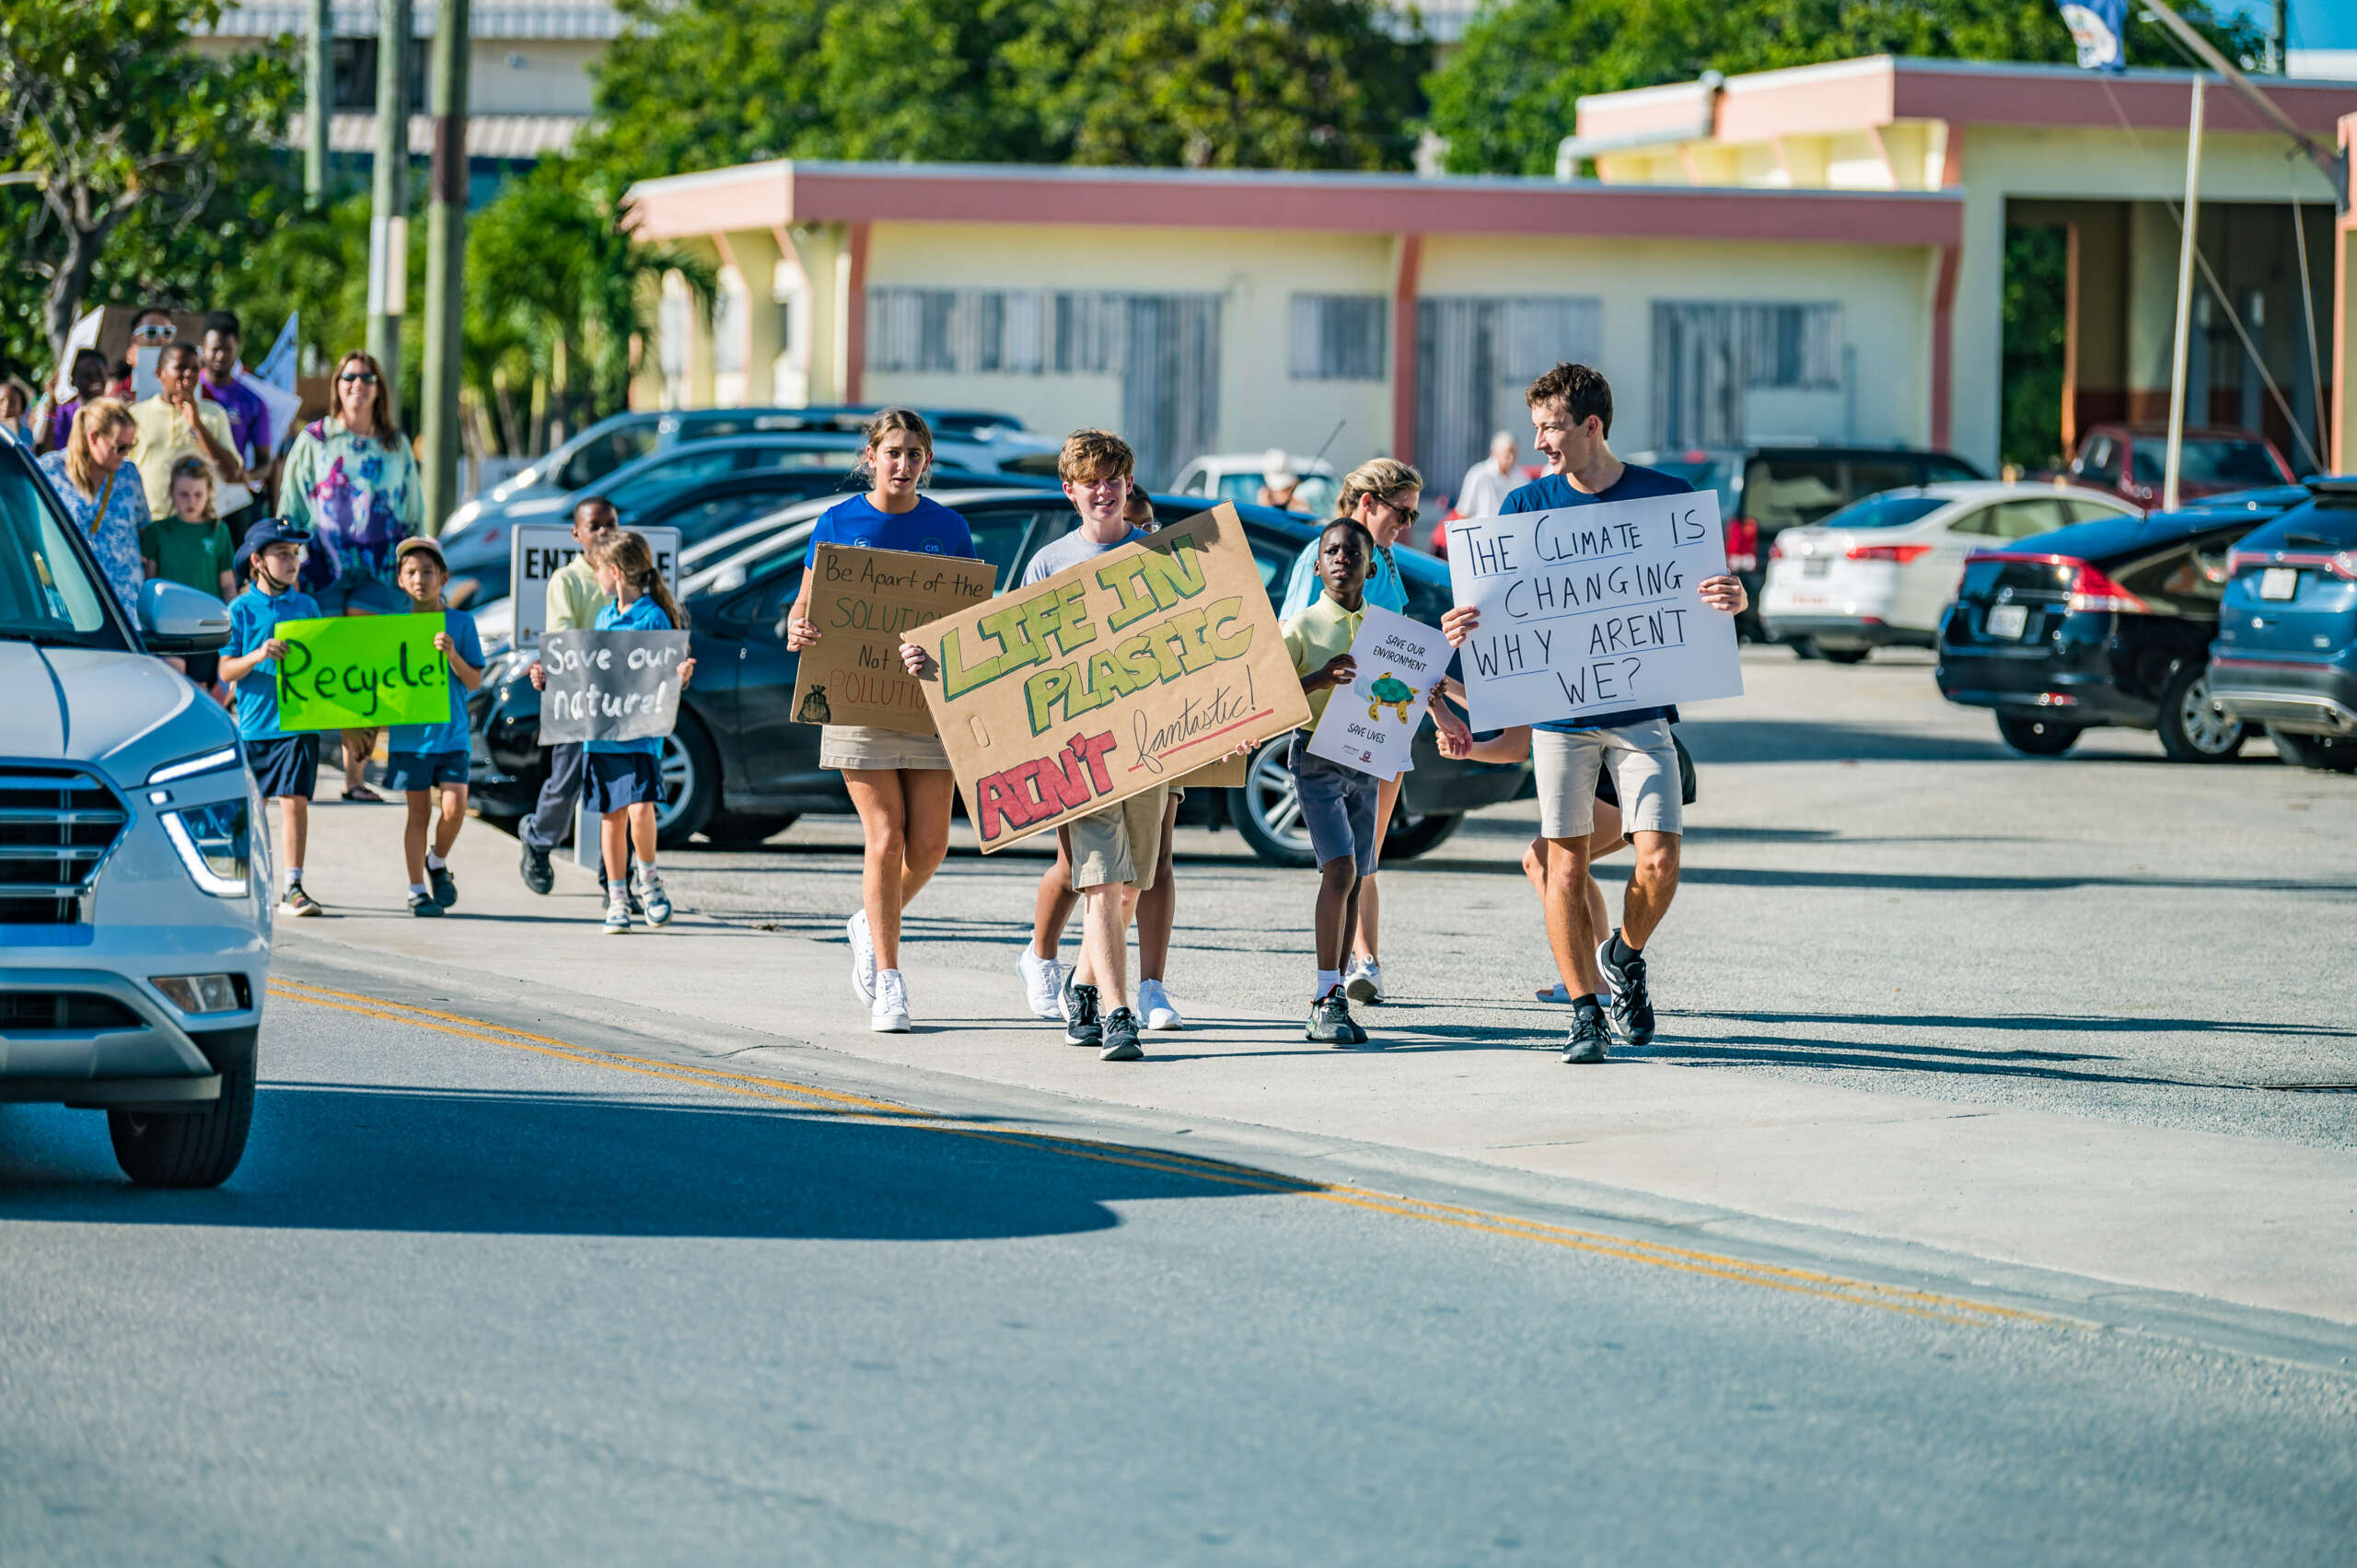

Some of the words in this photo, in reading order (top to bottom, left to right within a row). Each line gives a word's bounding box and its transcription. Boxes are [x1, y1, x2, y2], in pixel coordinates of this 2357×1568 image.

[924, 544, 940, 552] CIS
[1451, 526, 1518, 575] THE
[1535, 515, 1643, 562] CLIMATE
[1671, 509, 1705, 544] IS
[527, 549, 671, 582] ENTE
[825, 554, 853, 582] Be
[860, 556, 917, 594] Apart
[923, 572, 946, 592] of
[951, 574, 984, 598] the
[1504, 561, 1683, 618] CHANGING
[830, 597, 942, 633] SOLUTI
[940, 578, 1097, 703] LIFE
[1096, 533, 1206, 633] IN
[546, 637, 612, 675] Save
[627, 647, 678, 670] our
[858, 645, 890, 670] Not
[1373, 645, 1428, 672] ENVIRONMENT
[1386, 634, 1407, 650] SAVE
[1407, 643, 1426, 657] OUR
[1471, 629, 1551, 677] WHY
[1589, 607, 1687, 656] AREN'T
[281, 638, 446, 717] Recycle!
[1024, 596, 1254, 738] PLASTIC
[1557, 656, 1641, 704] WE?
[553, 680, 668, 721] nature!
[829, 669, 929, 711] POLLUTIO
[976, 729, 1117, 842] AIN'T
[1133, 664, 1256, 774] fantastic!
[1347, 723, 1367, 738] SAVE
[1366, 729, 1386, 744] LIVES
